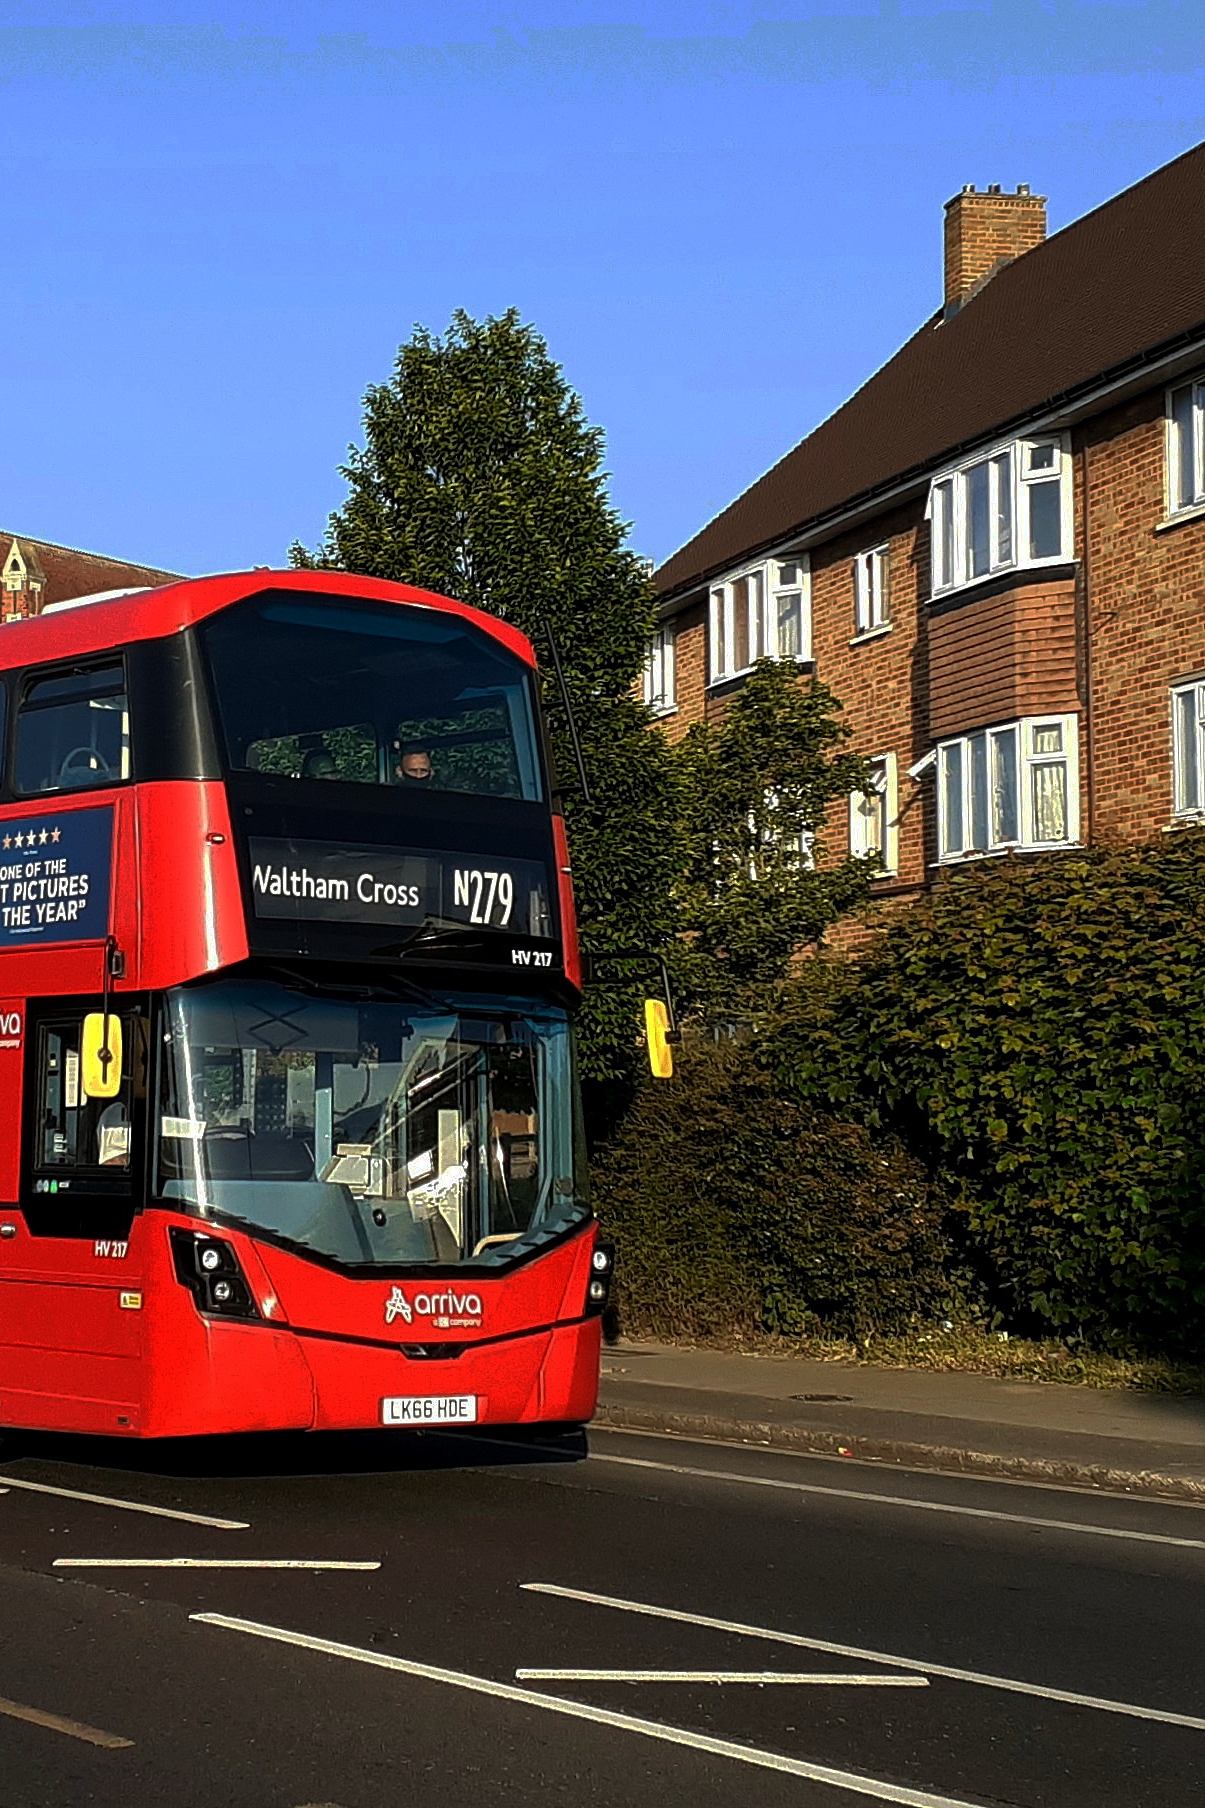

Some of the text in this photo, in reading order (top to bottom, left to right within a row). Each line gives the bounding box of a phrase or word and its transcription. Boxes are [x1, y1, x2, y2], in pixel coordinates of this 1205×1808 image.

[25, 862, 42, 878] OF
[44, 858, 67, 875] THE
[13, 874, 89, 902] PICTURES
[253, 864, 419, 907] Waltham Cross
[454, 869, 513, 925] N279
[2, 905, 31, 927] THE
[511, 949, 553, 967] HV 217
[95, 1240, 129, 1258] HV 217
[414, 1288, 482, 1315] arriva
[390, 1398, 469, 1420] LK66 HDE
